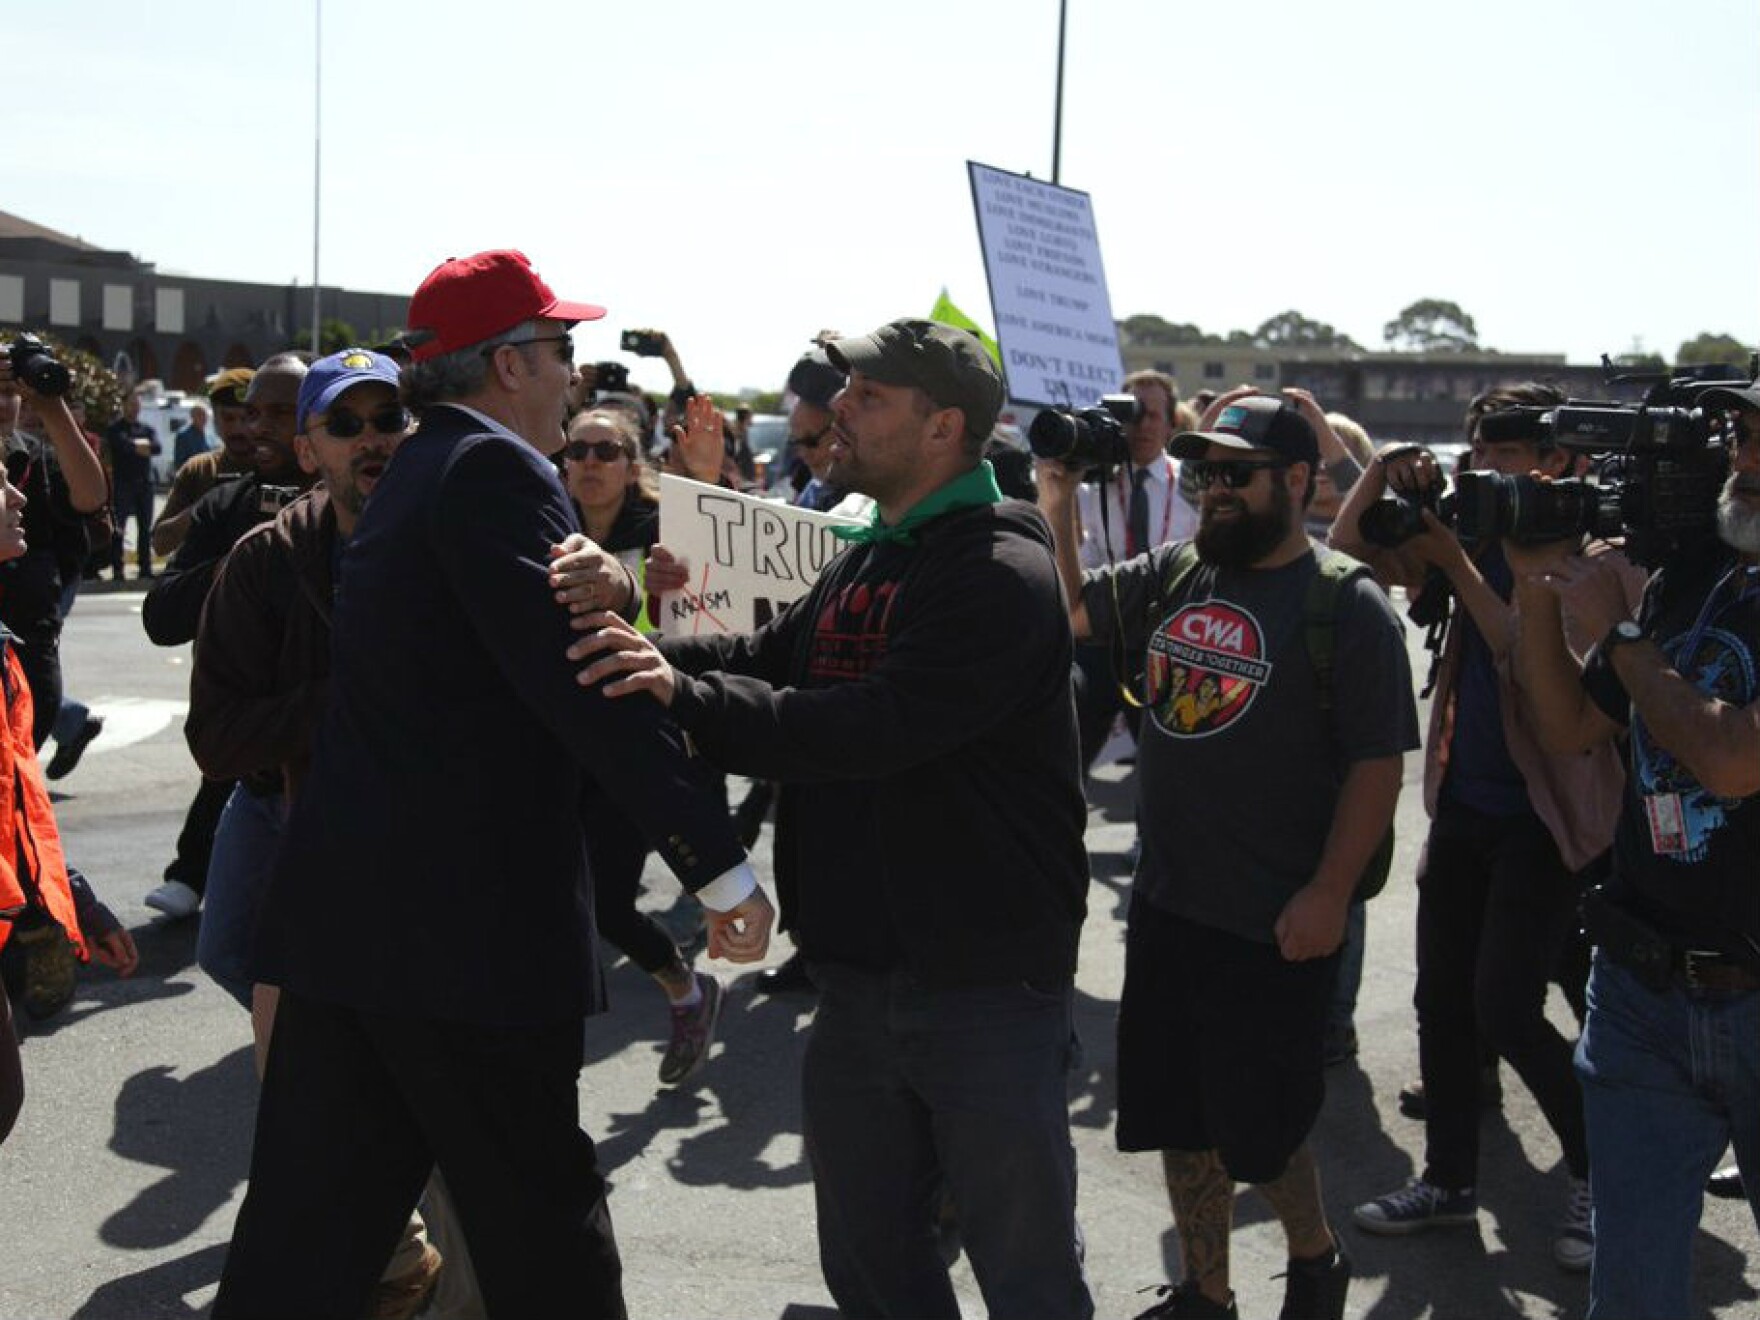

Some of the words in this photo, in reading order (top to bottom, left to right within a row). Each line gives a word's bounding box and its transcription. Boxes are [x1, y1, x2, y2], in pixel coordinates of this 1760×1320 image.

[995, 190, 1024, 206] LOVE
[986, 202, 1015, 218] LOVE
[1006, 223, 1036, 239] LOVE
[1004, 238, 1033, 254] LOVE
[998, 251, 1027, 267] LOVE
[1016, 286, 1045, 302] LOVE
[1049, 293, 1089, 311] TRUMP
[1010, 350, 1062, 374] DON'T
[1067, 360, 1118, 386] ELECT
[697, 494, 848, 588] TRU
[1182, 614, 1244, 651] CWA
[1207, 655, 1264, 677] TOGETHER
